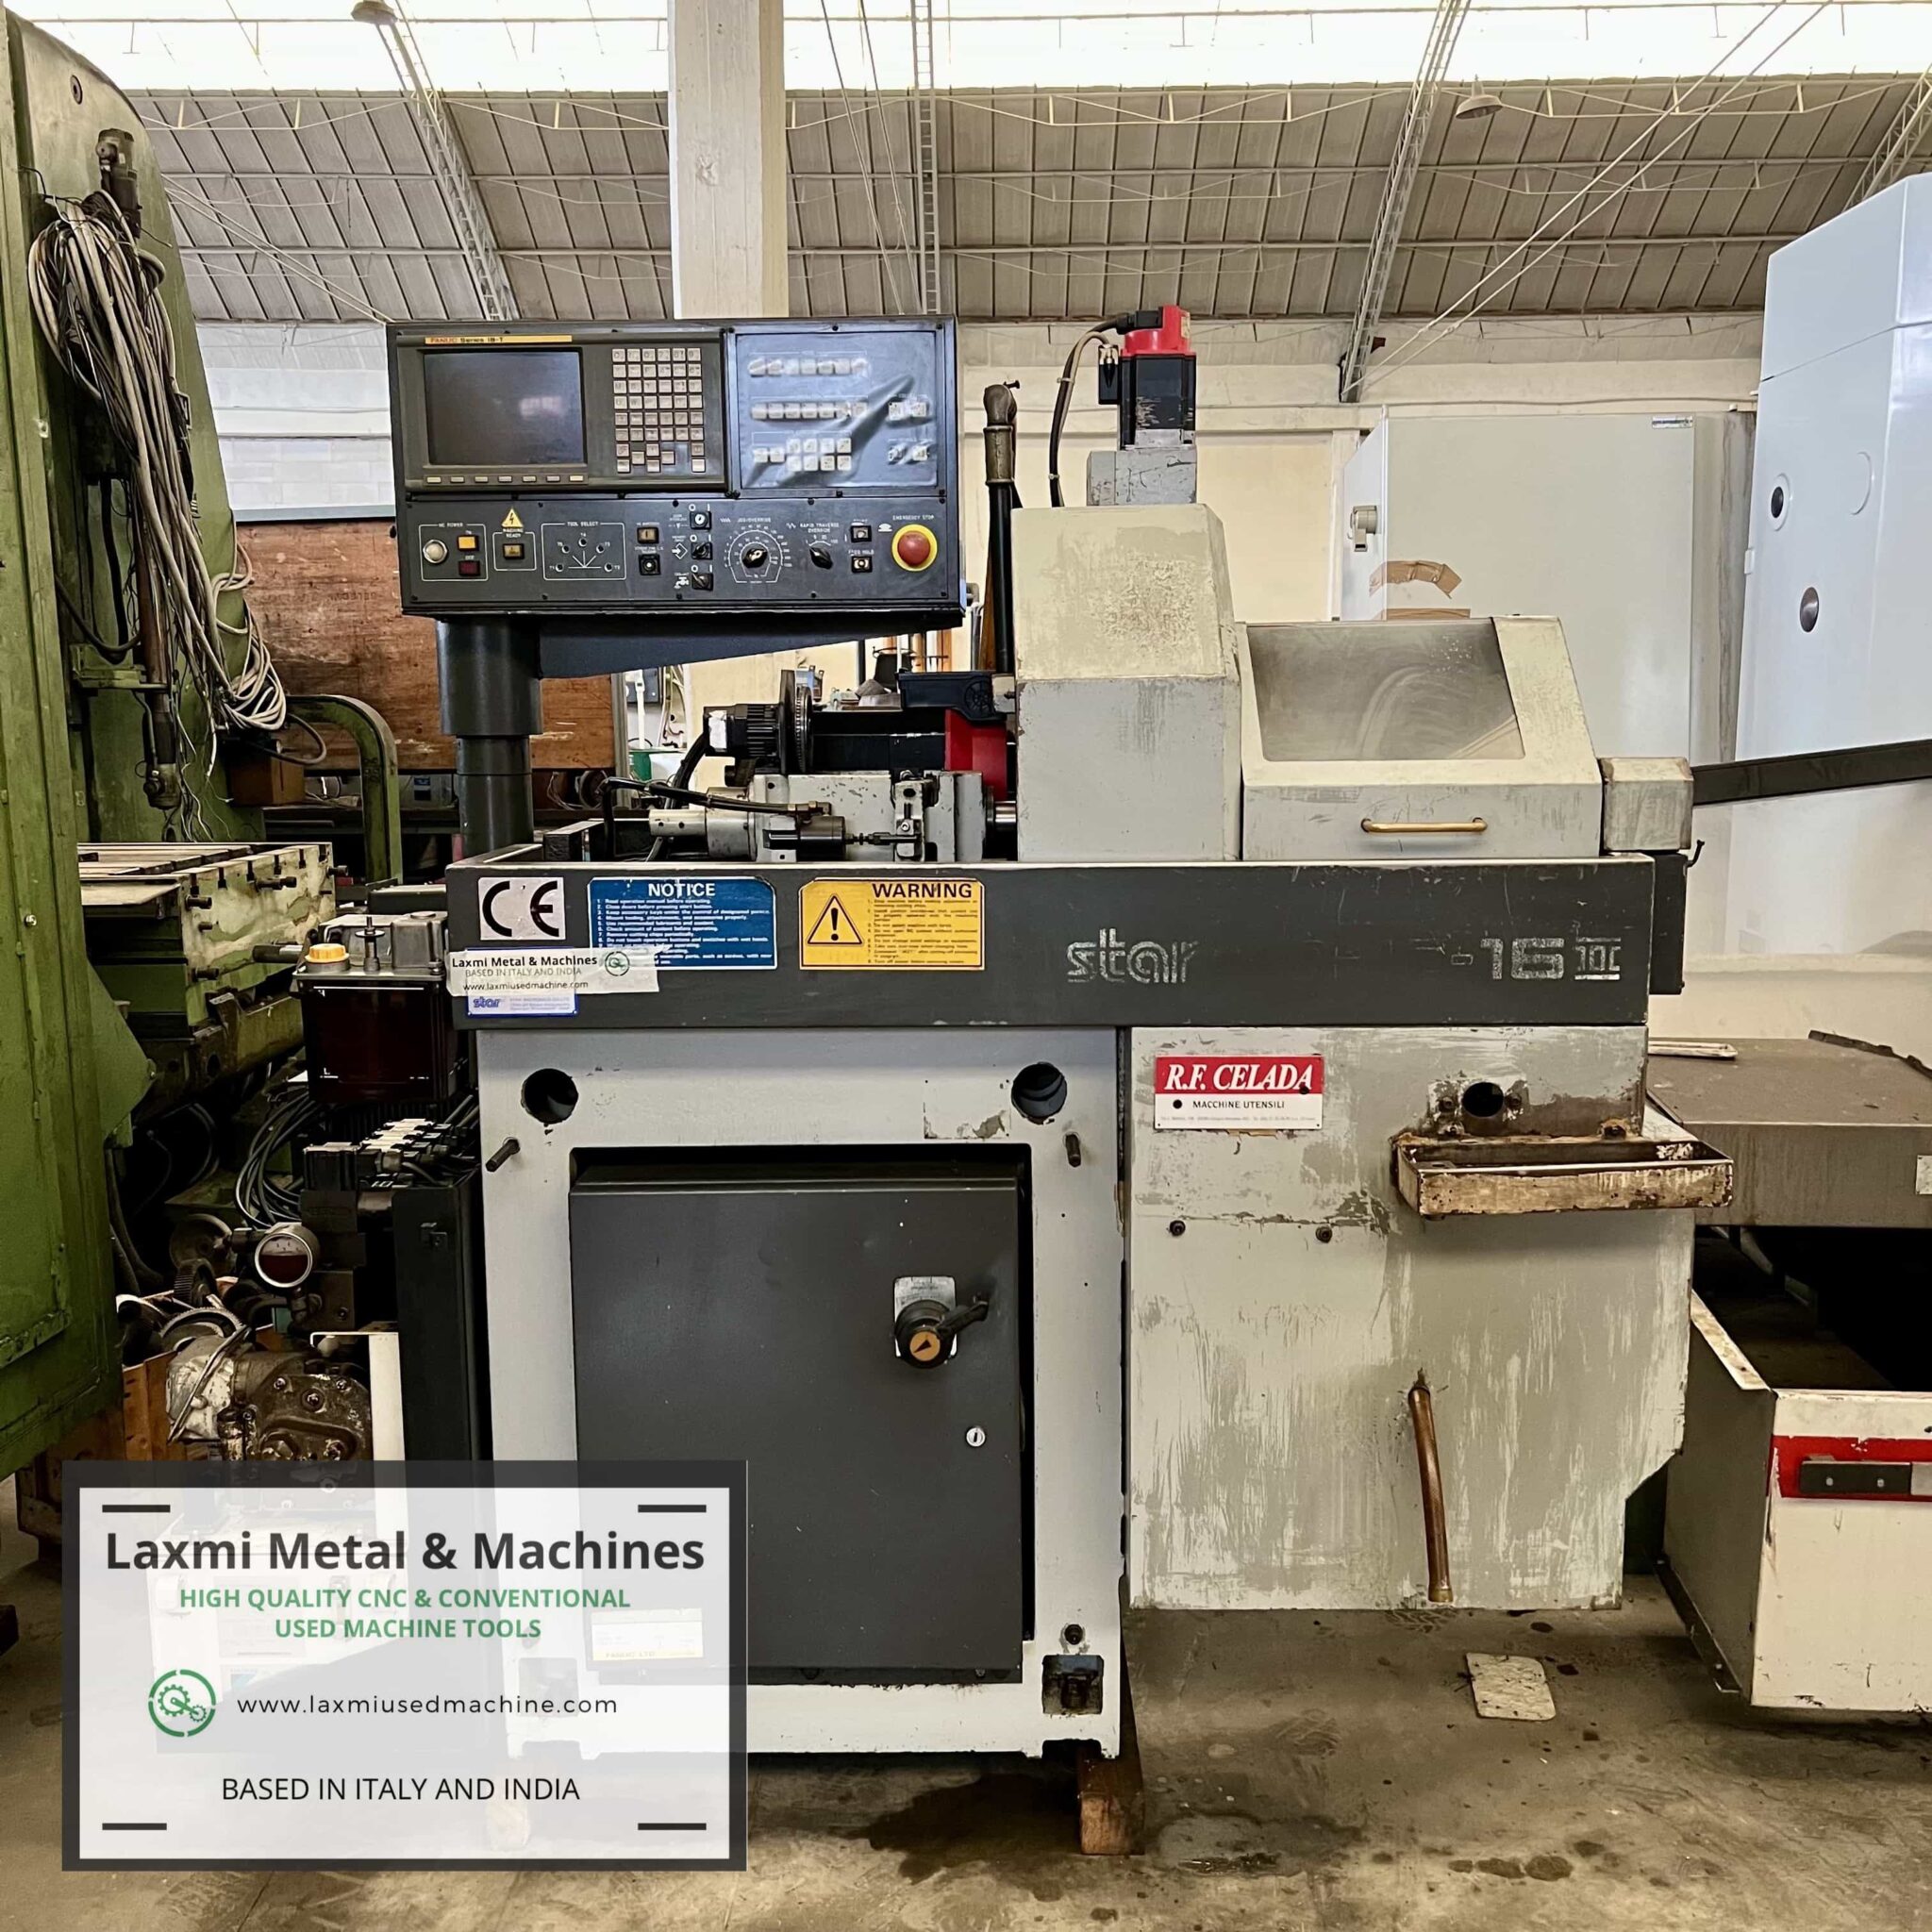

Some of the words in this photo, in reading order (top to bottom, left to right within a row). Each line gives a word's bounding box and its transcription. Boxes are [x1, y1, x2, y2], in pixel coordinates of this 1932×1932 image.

[648, 883, 716, 897] NOTICE
[872, 883, 972, 898] WARNING
[482, 880, 559, 937] CE
[452, 958, 487, 968] Laxmi
[491, 957, 525, 967] Metal
[529, 957, 538, 966] &
[541, 955, 597, 966] Machines
[1067, 928, 1199, 983] star
[466, 969, 493, 977] BASED
[508, 968, 532, 976] ITALY
[557, 967, 582, 975] INDIA
[463, 981, 589, 991] www.laxmiusedmachine.com
[474, 996, 500, 1008] star
[1164, 1064, 1208, 1091] R.F.
[1213, 1064, 1313, 1091] CELADA
[1243, 1100, 1285, 1108] UTENSILI
